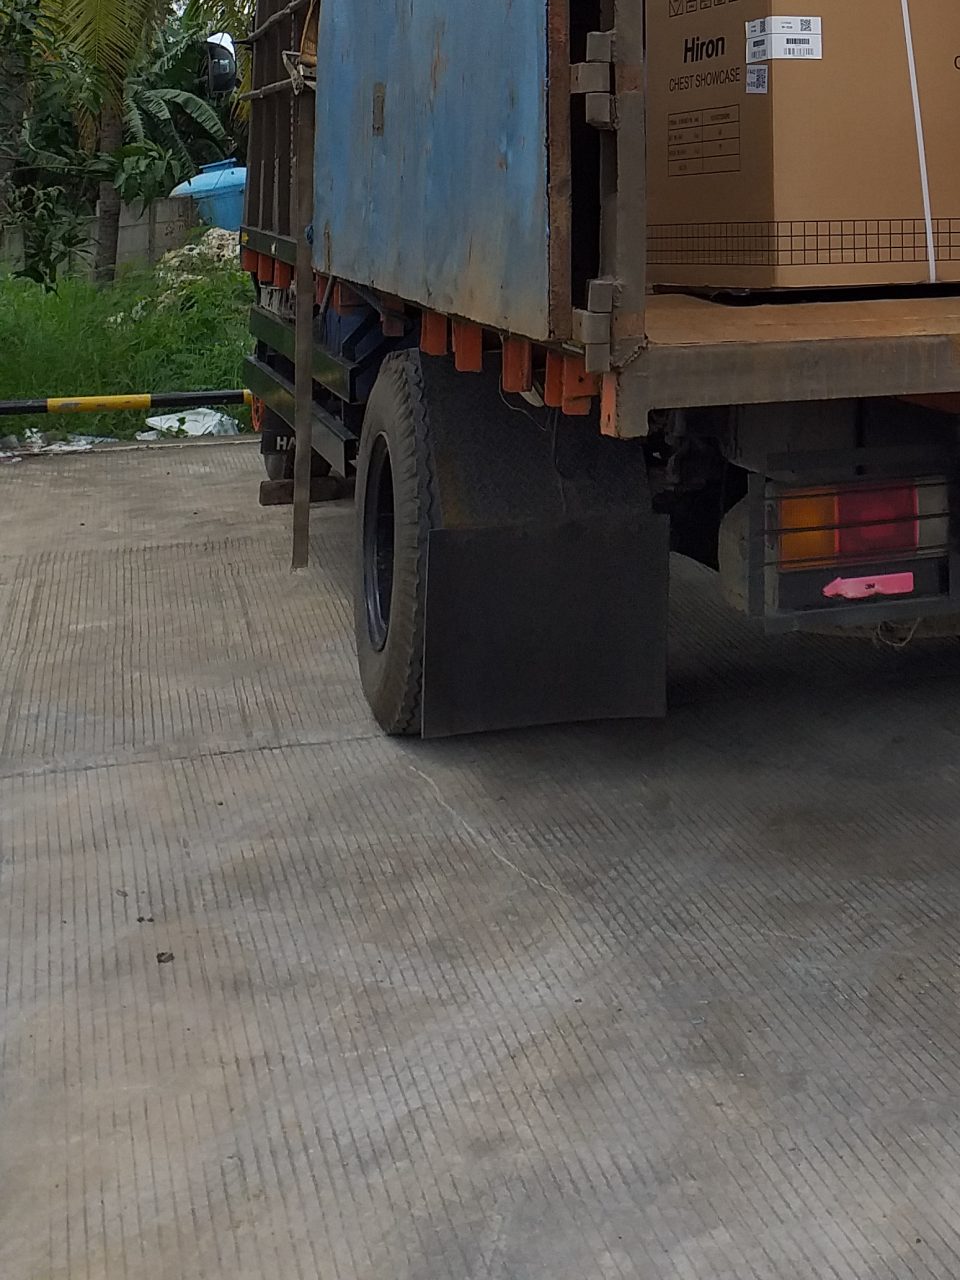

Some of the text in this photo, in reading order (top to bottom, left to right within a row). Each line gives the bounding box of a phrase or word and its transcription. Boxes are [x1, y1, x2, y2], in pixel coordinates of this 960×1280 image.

[684, 36, 725, 64] Hiron
[669, 75, 693, 93] CHEST
[696, 67, 740, 89] SHOWCASE
